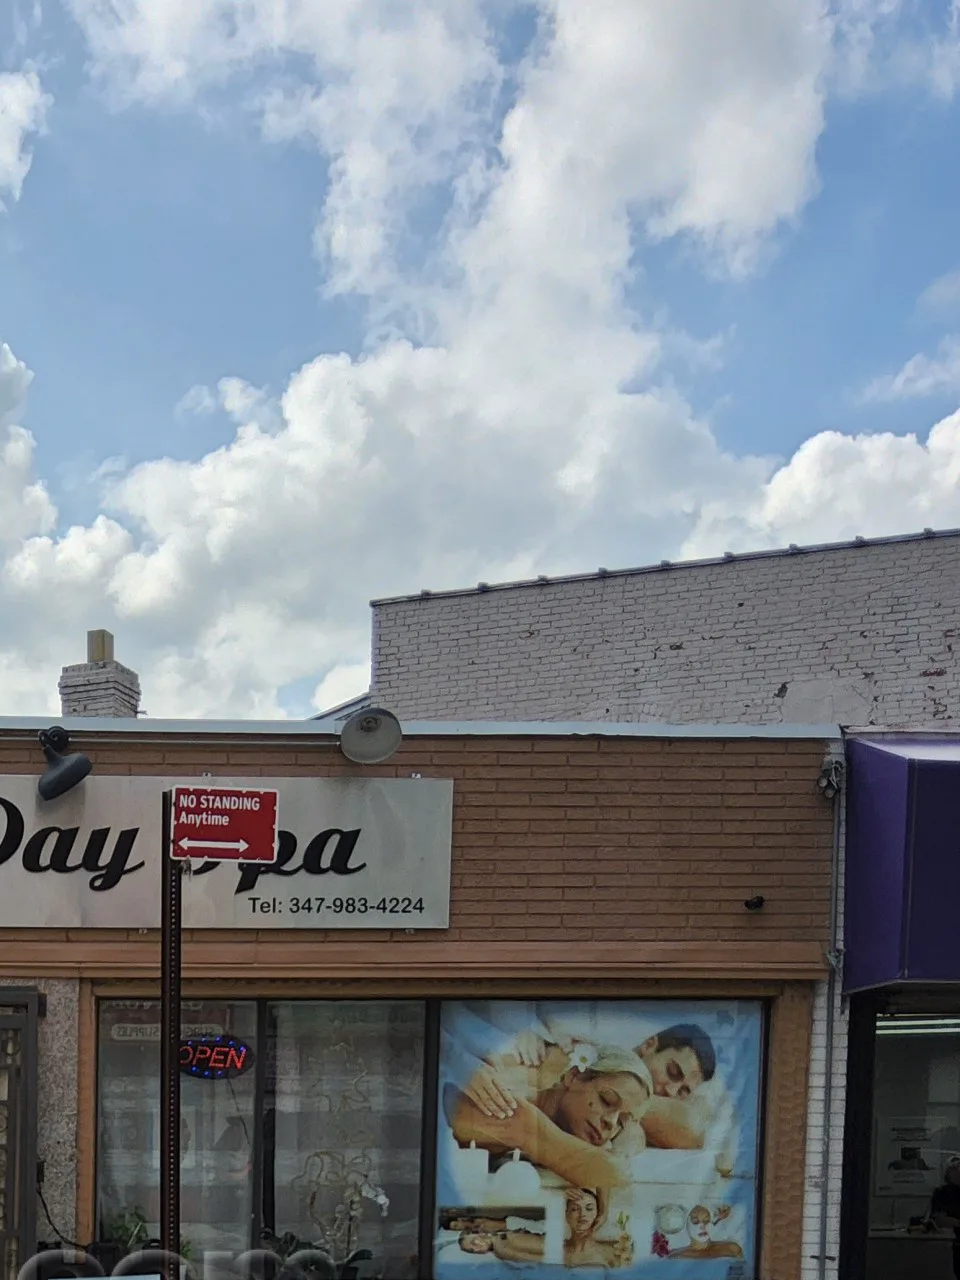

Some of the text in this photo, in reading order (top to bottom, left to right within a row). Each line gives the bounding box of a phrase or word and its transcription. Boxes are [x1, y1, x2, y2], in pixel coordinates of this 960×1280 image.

[179, 794, 261, 811] NO STANDING
[179, 811, 229, 827] Anytime
[193, 828, 367, 895] pa
[248, 897, 425, 914] Tel: 347-983-4224
